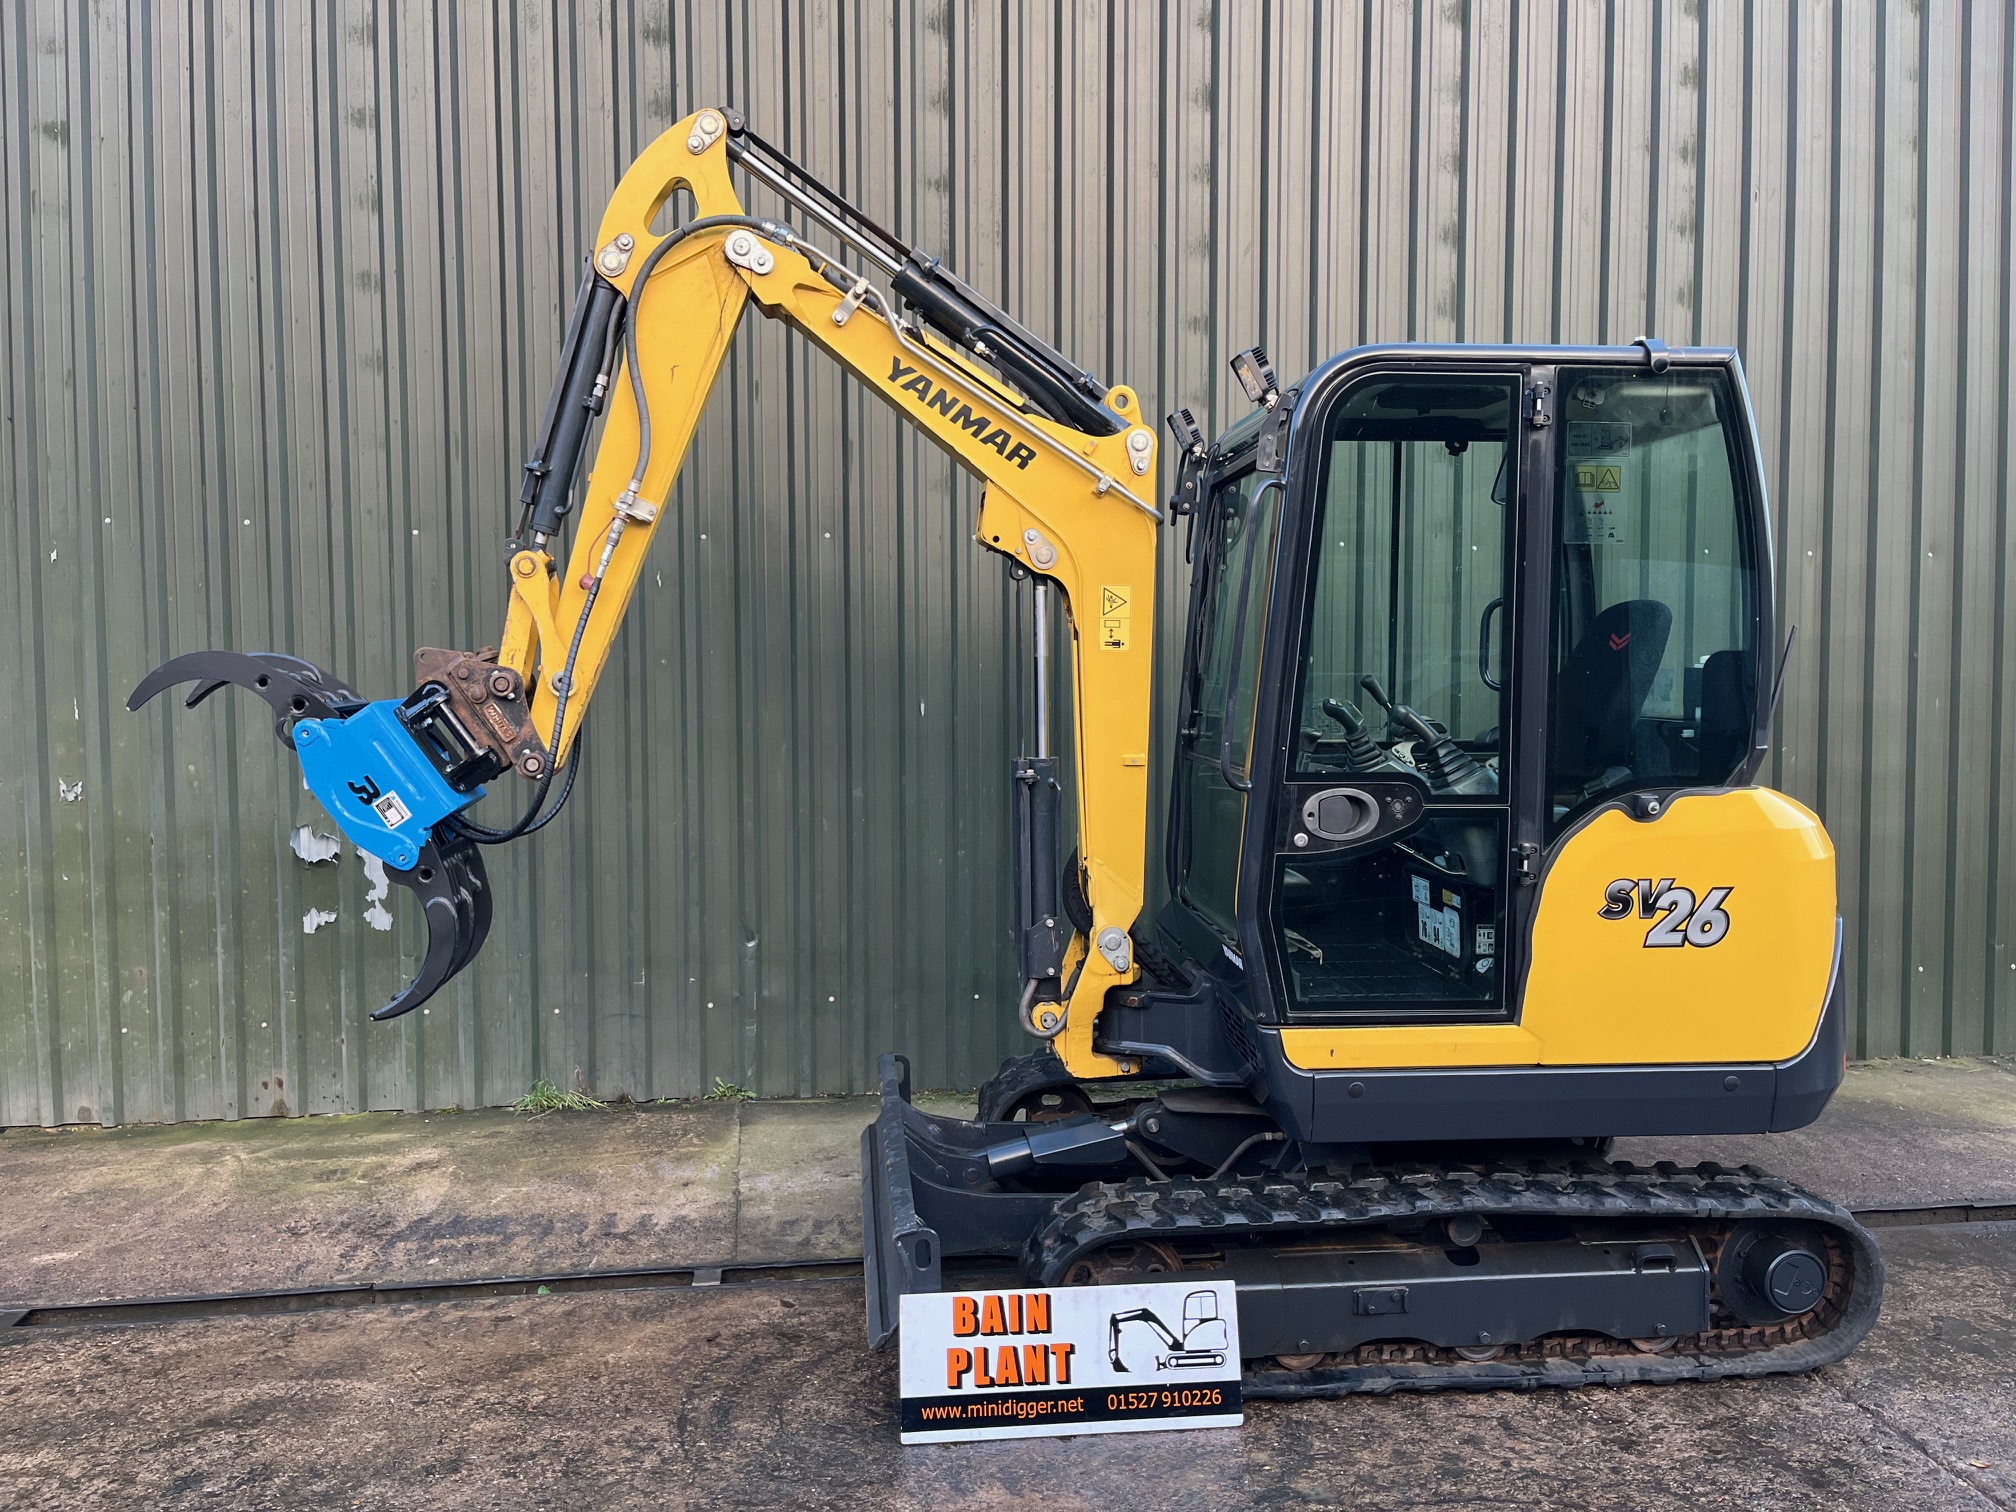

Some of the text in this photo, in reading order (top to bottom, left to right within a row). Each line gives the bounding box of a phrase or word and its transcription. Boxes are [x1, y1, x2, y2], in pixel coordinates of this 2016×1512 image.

[887, 355, 1037, 471] YANMAR
[487, 705, 512, 738] WHITES
[1597, 878, 1735, 948] SV26
[953, 1293, 1052, 1337] BAIN
[946, 1343, 1075, 1389] PLANT
[921, 1389, 1222, 1420] www.minidigger.net 01527 910226
